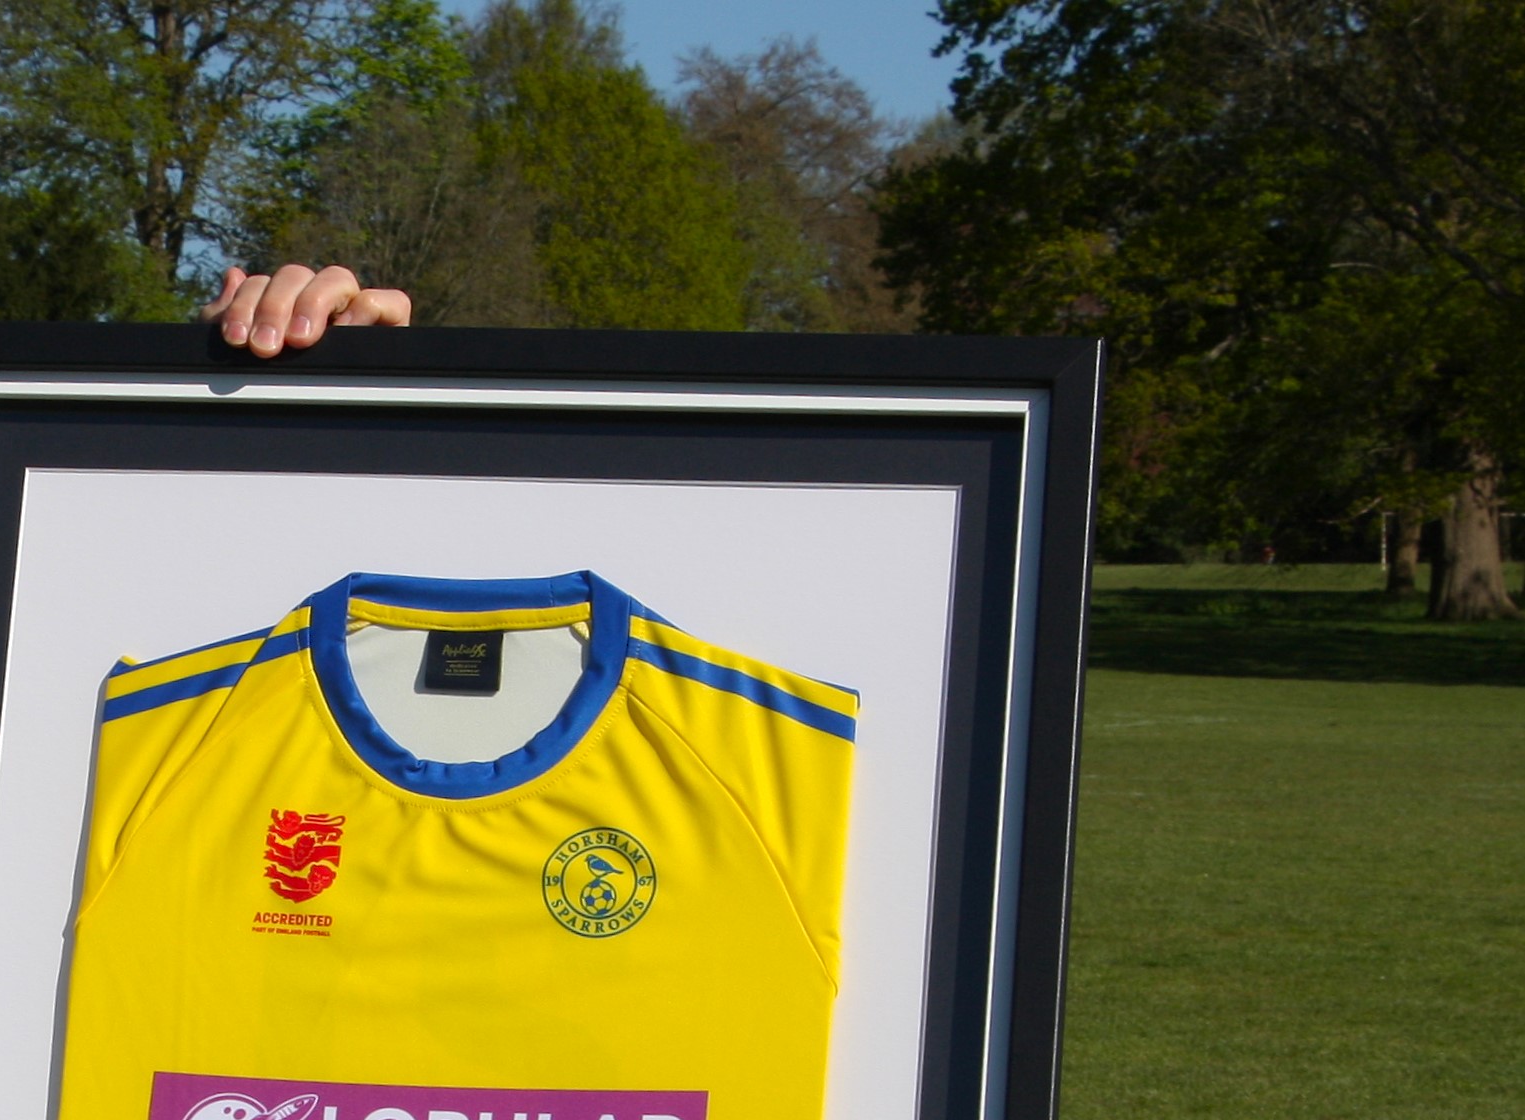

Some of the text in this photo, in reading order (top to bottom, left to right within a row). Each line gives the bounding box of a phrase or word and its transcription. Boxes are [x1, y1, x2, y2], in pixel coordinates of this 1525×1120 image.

[555, 832, 644, 864] HORSHAM
[545, 875, 560, 887] 19
[637, 875, 654, 887] 67
[253, 911, 333, 927] ACCREDITED
[551, 899, 644, 933] SPARROWS
